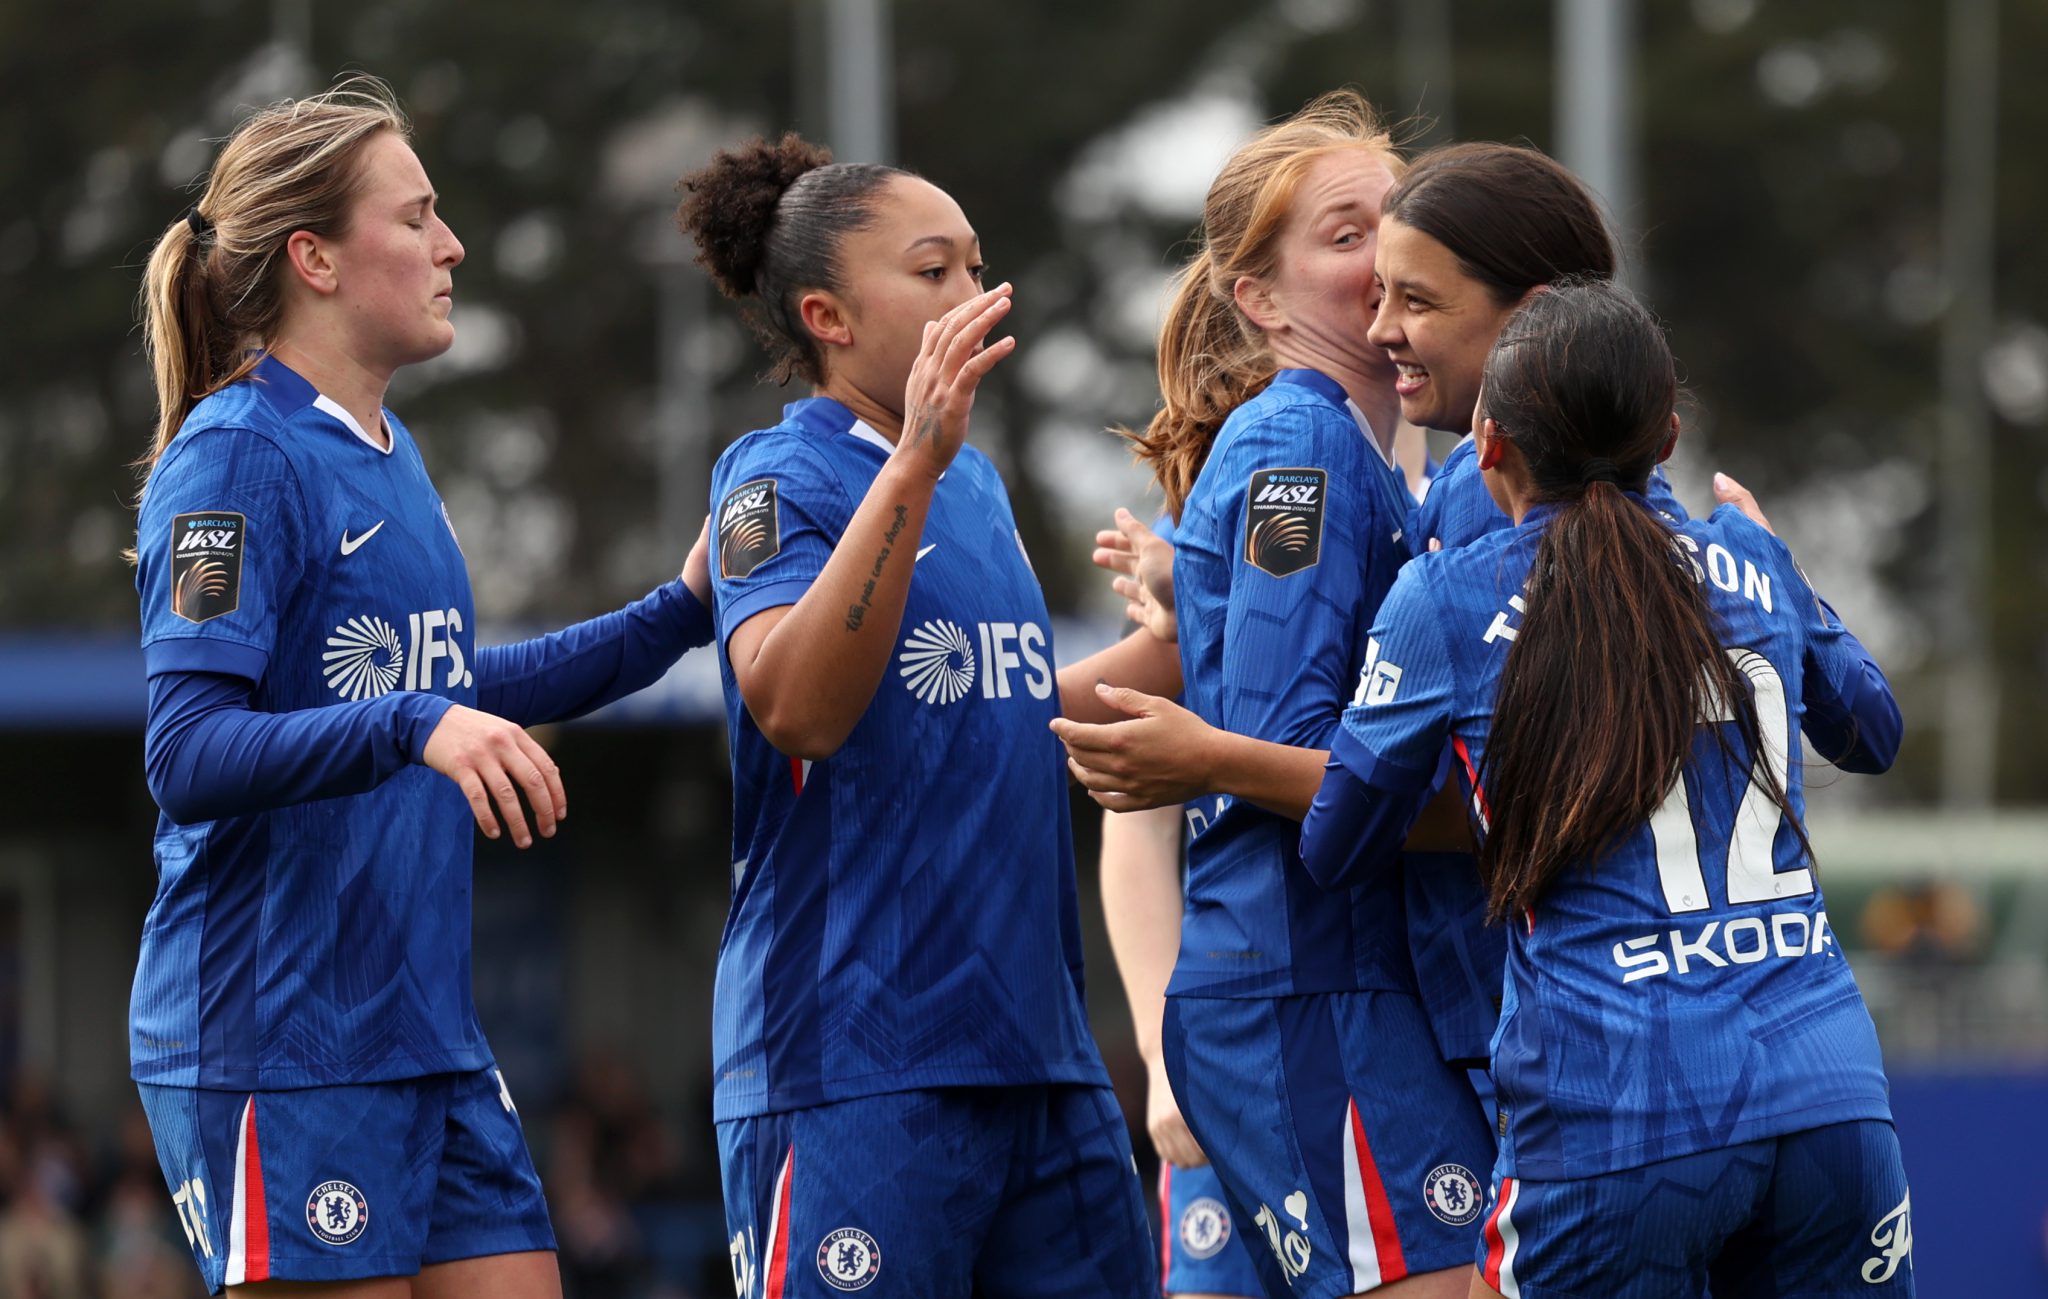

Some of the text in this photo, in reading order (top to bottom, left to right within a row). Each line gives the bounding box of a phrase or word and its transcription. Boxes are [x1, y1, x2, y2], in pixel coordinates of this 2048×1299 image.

[1278, 475, 1319, 484] BARCLAYS
[733, 483, 768, 501] BARCLAYS
[1254, 484, 1319, 504] WSL
[720, 490, 770, 529] WSL
[197, 519, 237, 528] BARCLAYS
[176, 529, 237, 551] WSL
[977, 622, 1053, 700] IFS
[1430, 1166, 1467, 1182] CHELSEA
[316, 1183, 355, 1197] CHELSEA
[318, 1229, 344, 1241] FOOTBALL
[831, 1230, 871, 1247] CHELSEA
